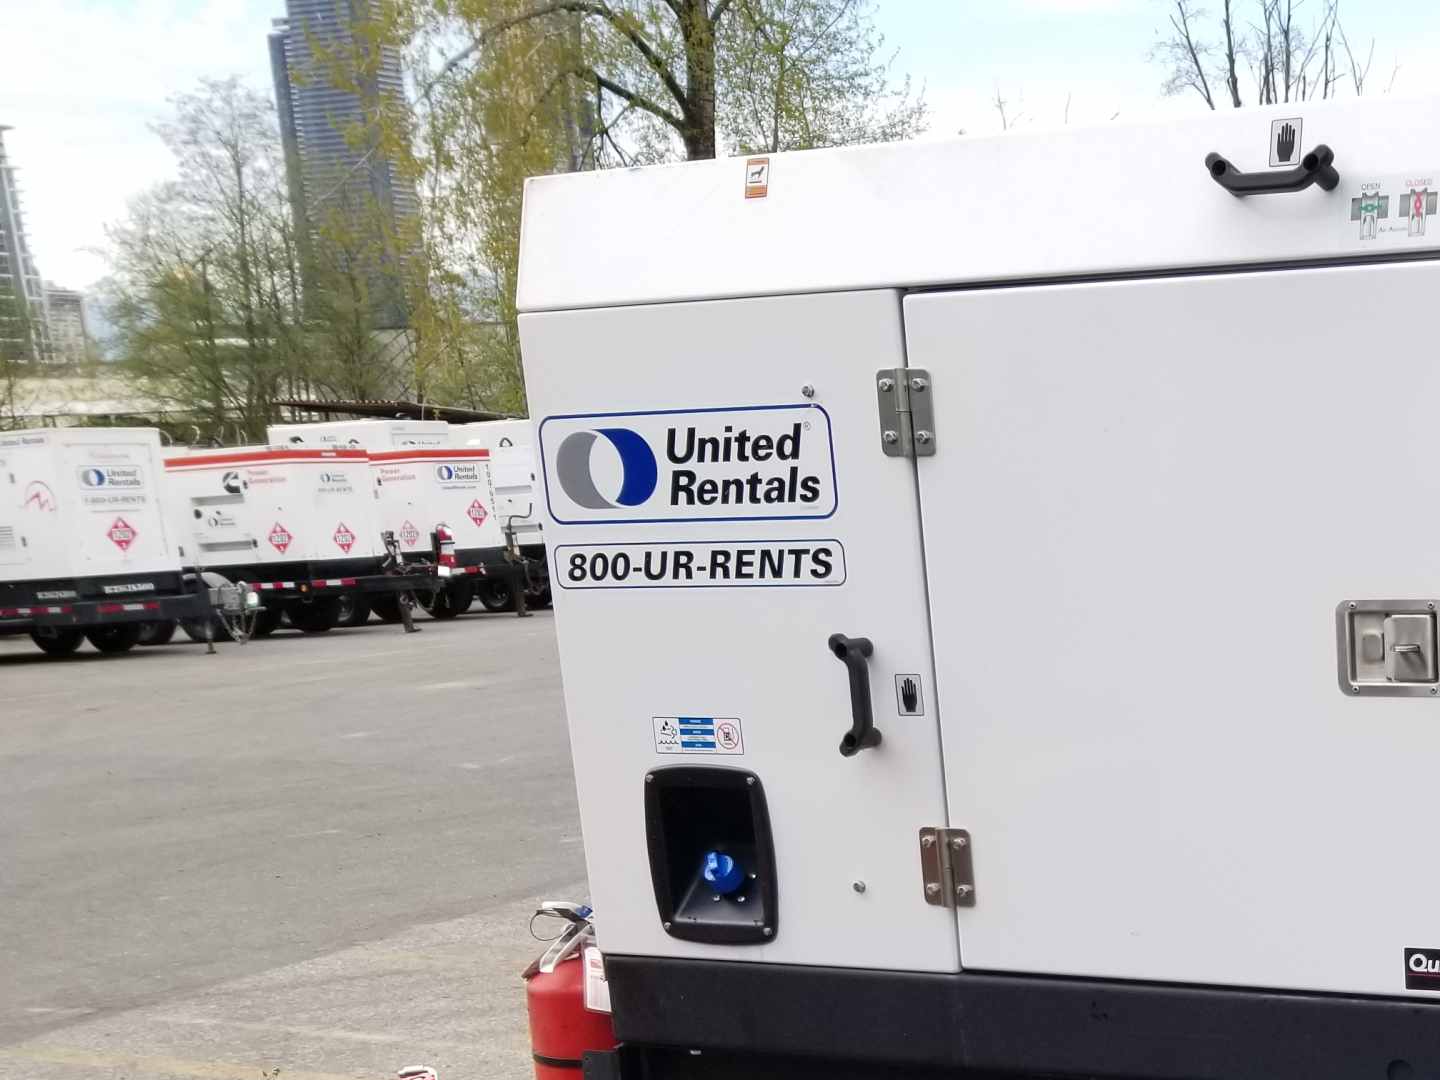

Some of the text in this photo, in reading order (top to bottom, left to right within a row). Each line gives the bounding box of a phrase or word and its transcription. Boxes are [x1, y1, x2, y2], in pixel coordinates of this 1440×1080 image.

[666, 423, 802, 465] United
[670, 466, 821, 507] Rentals
[568, 547, 834, 582] 800-UR-RENTS
